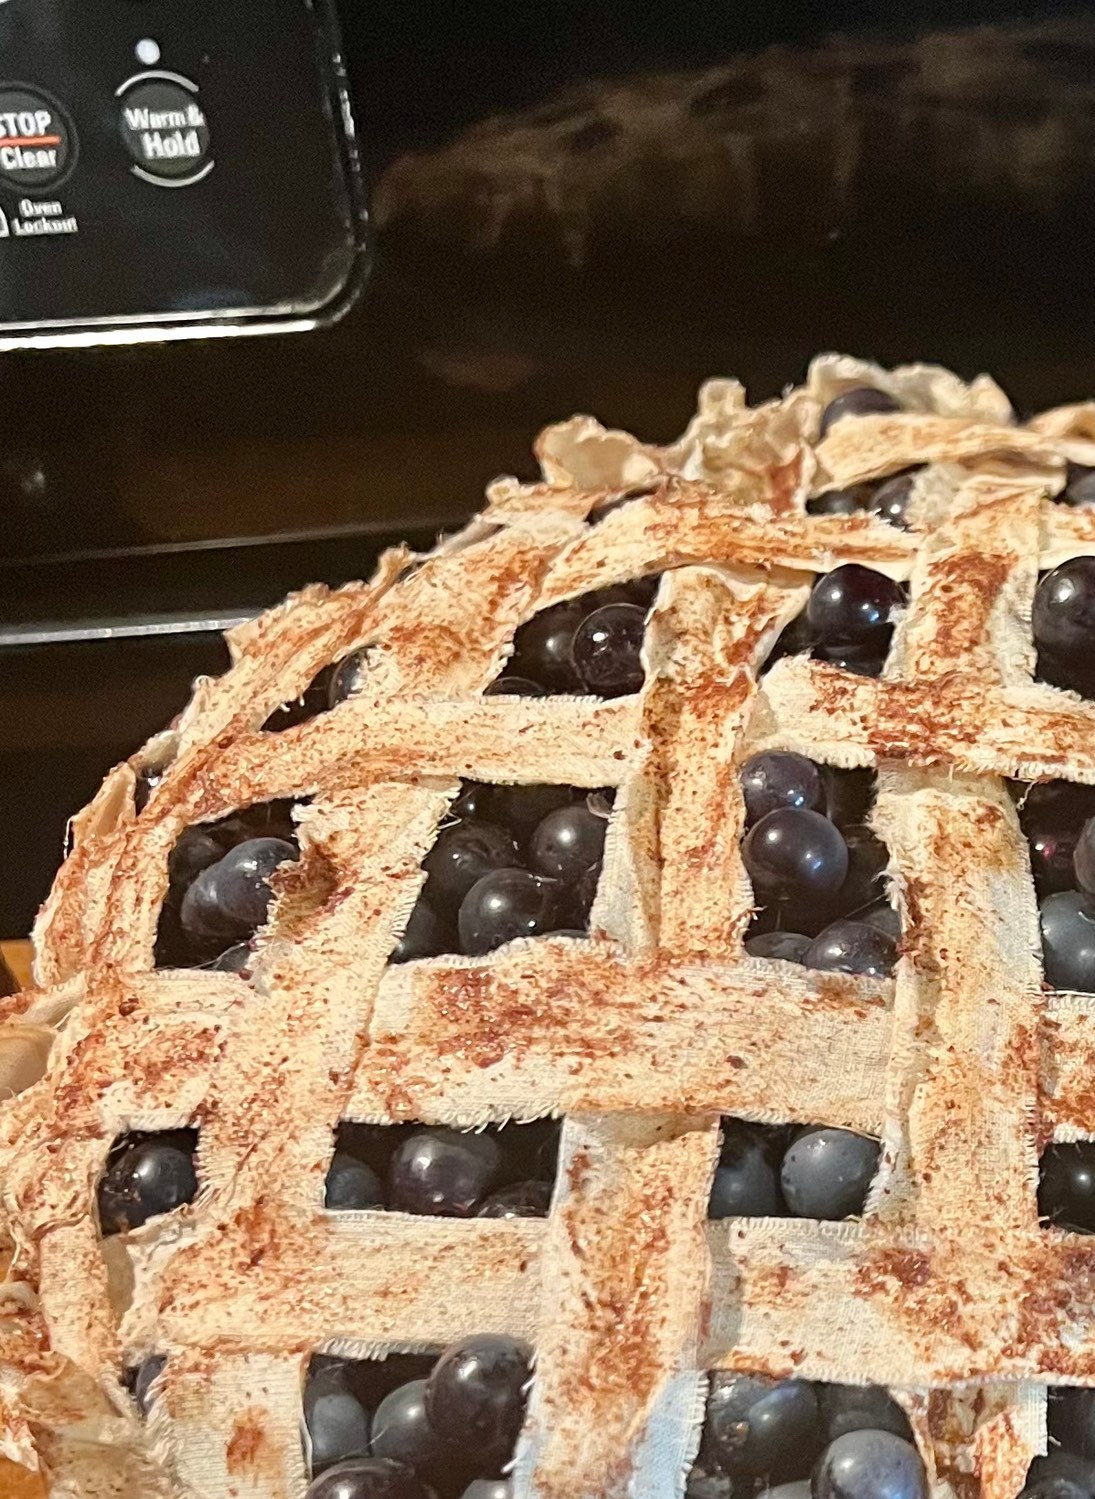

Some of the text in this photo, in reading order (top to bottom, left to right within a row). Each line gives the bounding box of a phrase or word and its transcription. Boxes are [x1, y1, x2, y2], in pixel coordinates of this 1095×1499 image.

[123, 103, 205, 131] Warm &
[0, 145, 57, 170] Clear
[142, 129, 201, 160] Hold
[19, 198, 63, 217] Oven
